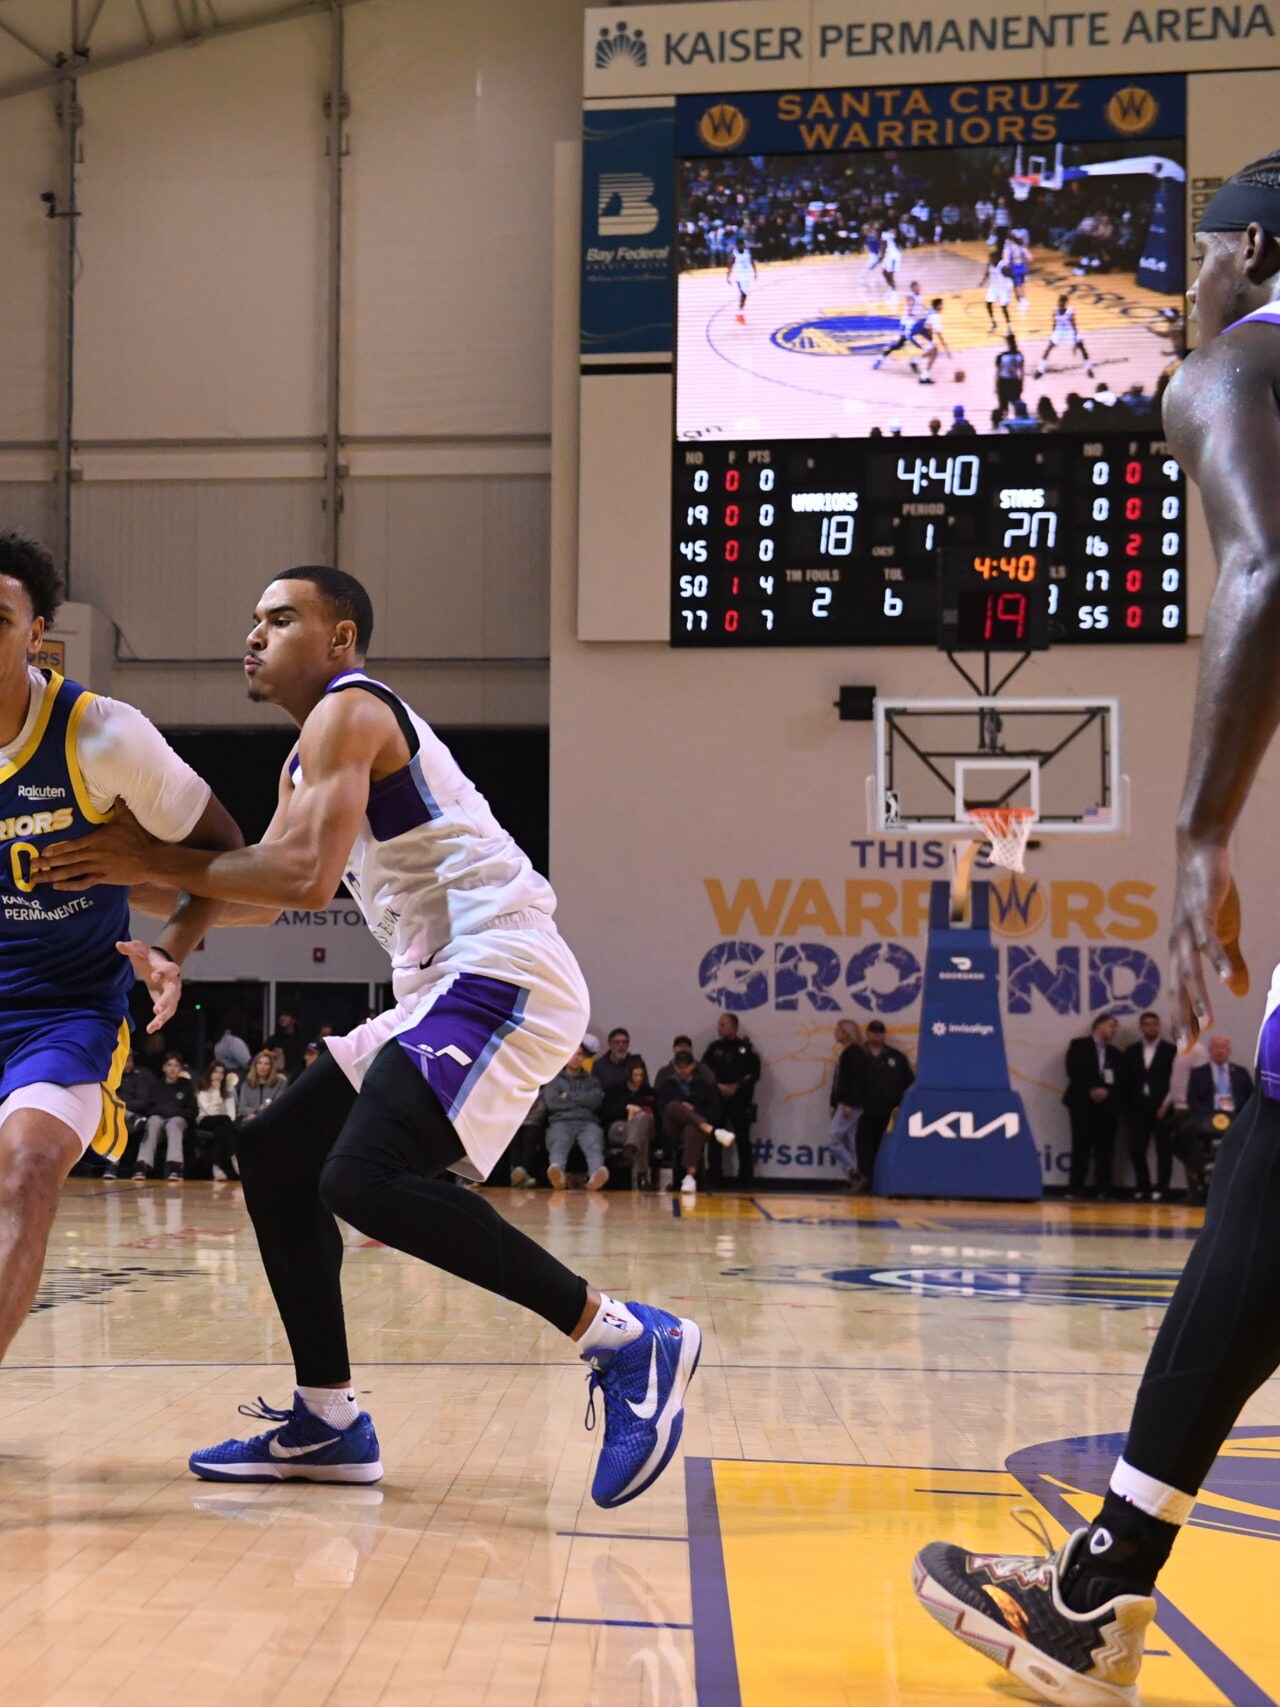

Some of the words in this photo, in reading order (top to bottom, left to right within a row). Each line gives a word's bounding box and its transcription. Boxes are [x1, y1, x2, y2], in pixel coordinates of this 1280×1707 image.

[663, 25, 803, 66] KAISER
[820, 12, 1109, 59] PERMANENTE
[1123, 3, 1274, 44] ARENA
[776, 89, 931, 121] SANTA
[949, 82, 1082, 116] CRUZ
[798, 114, 1058, 151] WARRIORS
[586, 248, 615, 264] Bay
[616, 246, 670, 260] Federal
[686, 452, 704, 465] NO
[728, 451, 737, 464] F
[748, 451, 770, 463] PTS
[694, 470, 709, 492] 0
[725, 470, 739, 492] 0
[759, 469, 775, 491] 0
[897, 455, 980, 496] 4:40
[1092, 461, 1110, 485] 0
[1125, 461, 1142, 484] 0
[1162, 460, 1179, 481] 9
[791, 492, 859, 512] WARRIORS
[902, 503, 945, 516] PERIOD
[1092, 497, 1110, 521] 0
[1125, 497, 1142, 520] 0
[1162, 496, 1179, 520] 0
[686, 504, 709, 526] 19
[725, 505, 739, 527] 0
[759, 504, 774, 527] 0
[820, 515, 855, 556] 18
[925, 522, 934, 551] 1
[1085, 535, 1109, 557] 16
[1125, 533, 1142, 556] 2
[1162, 532, 1179, 556] 0
[679, 539, 708, 562] 45
[725, 540, 739, 562] 0
[759, 539, 774, 562] 0
[786, 569, 802, 582] TM
[806, 569, 840, 582] FOULS
[884, 568, 904, 581] TOL
[973, 555, 1037, 582] 4:40
[1085, 569, 1110, 592] 17
[1125, 569, 1142, 592] 0
[1162, 568, 1179, 592] 0
[679, 574, 708, 597] 50
[731, 576, 739, 595] 1
[759, 575, 774, 595] 4
[812, 587, 832, 617] 2
[883, 587, 903, 616] 6
[681, 609, 708, 631] 77
[725, 609, 739, 632] 0
[761, 609, 774, 631] 7
[984, 593, 1026, 639] 19
[1078, 605, 1109, 629] 55
[1125, 605, 1142, 628] 0
[1162, 604, 1179, 628] 0
[18, 785, 66, 799] Rakuten
[850, 840, 944, 868] THIS
[5, 897, 90, 920] PERMANENTE
[704, 876, 1160, 941] WARORS
[697, 941, 1161, 1014] GROND
[908, 1111, 1019, 1139] KIA
